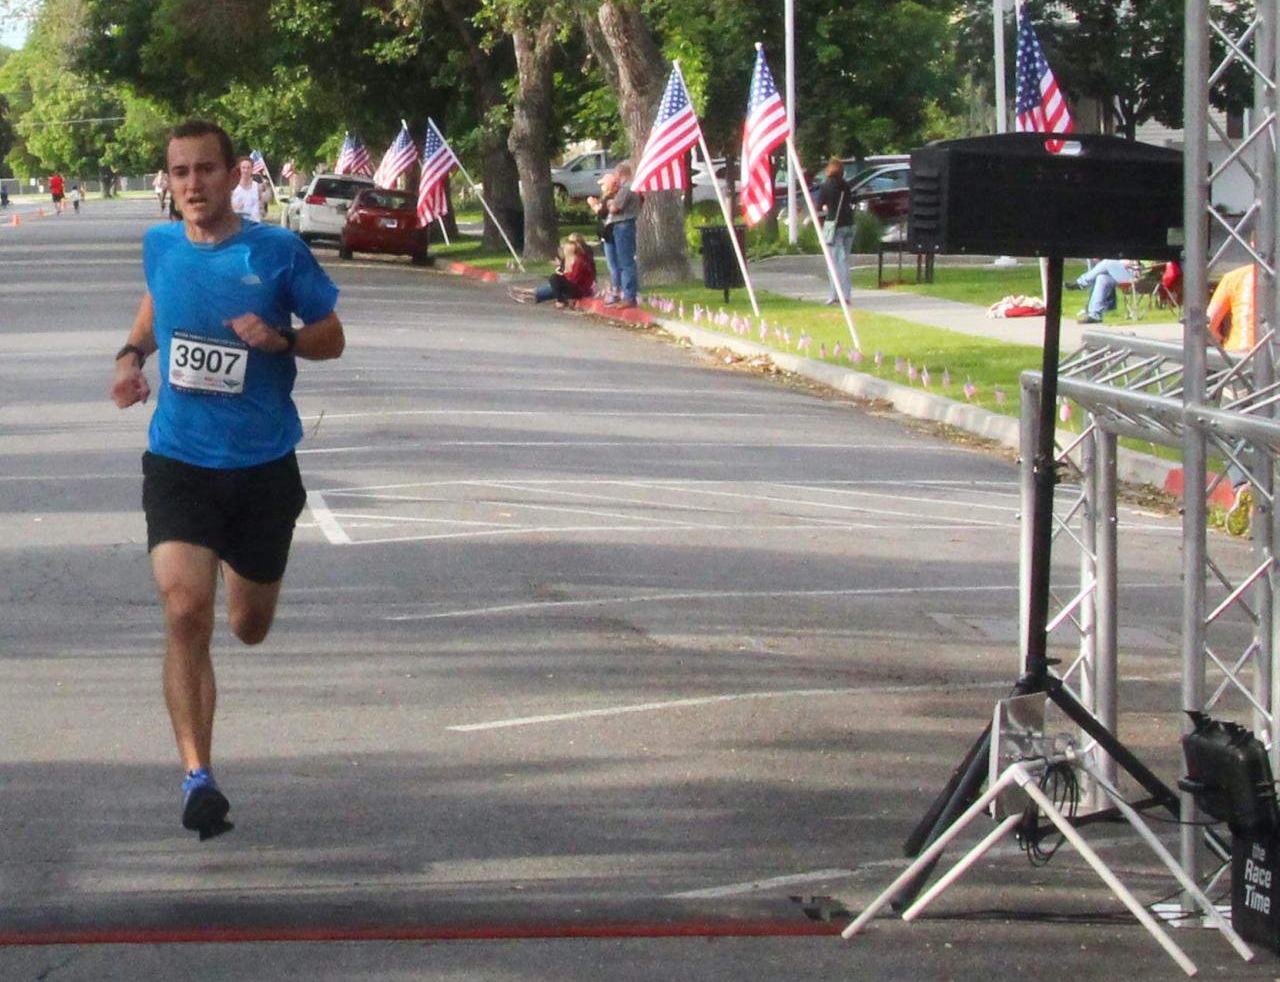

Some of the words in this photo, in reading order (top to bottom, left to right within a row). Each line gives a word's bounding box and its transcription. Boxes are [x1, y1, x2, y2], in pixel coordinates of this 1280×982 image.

[175, 344, 241, 375] 3907
[1244, 858, 1272, 889] Race
[1244, 884, 1271, 915] Time
